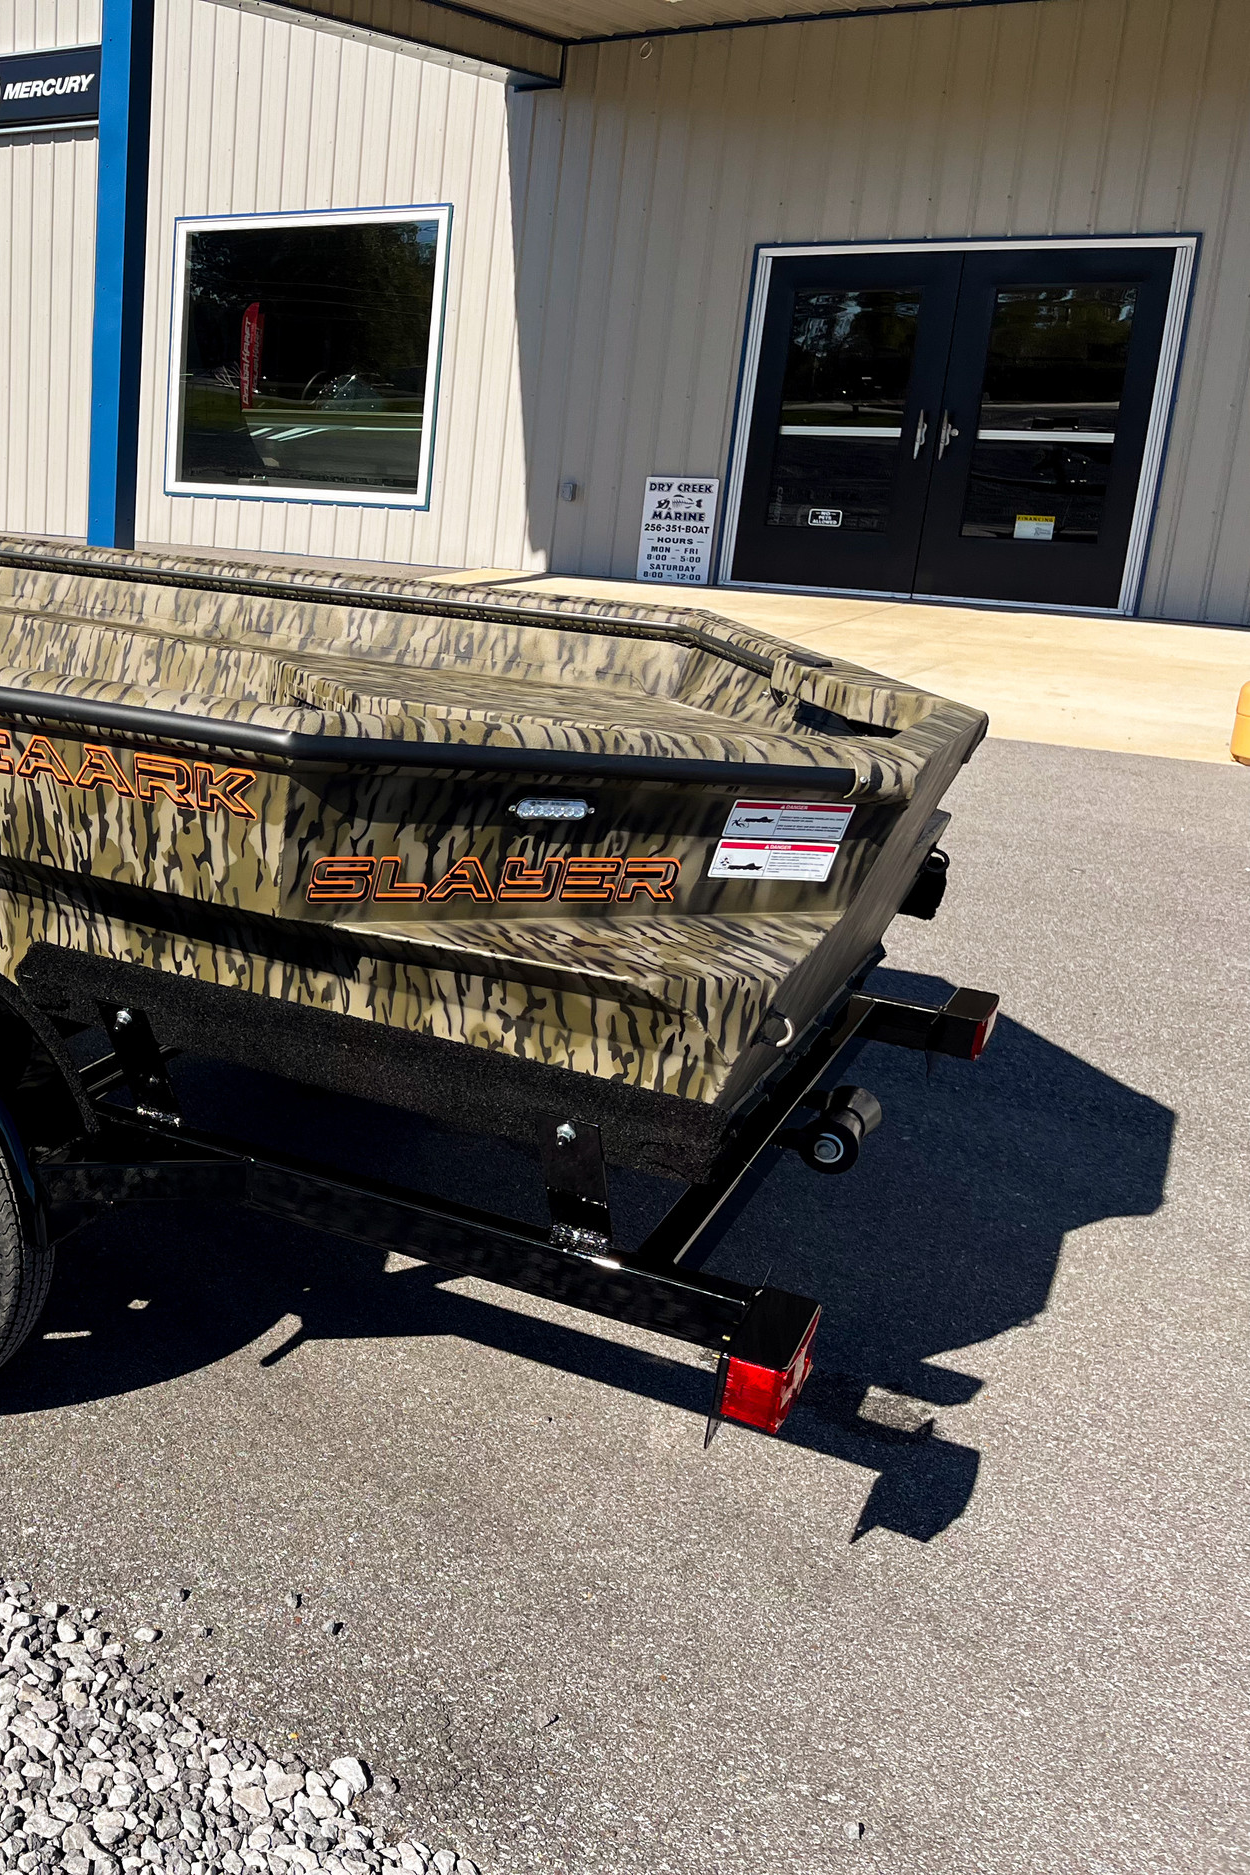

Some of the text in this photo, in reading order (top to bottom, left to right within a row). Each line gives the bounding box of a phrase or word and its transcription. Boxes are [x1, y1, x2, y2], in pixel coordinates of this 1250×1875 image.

[3, 74, 95, 100] MERCURY
[649, 482, 714, 493] DRY CREEK
[651, 511, 706, 522] MARINE
[644, 523, 710, 534] 256-351-BOAT
[657, 537, 693, 545] HOURS
[649, 564, 696, 572] SATURDAY
[306, 856, 682, 904] SLAYER
